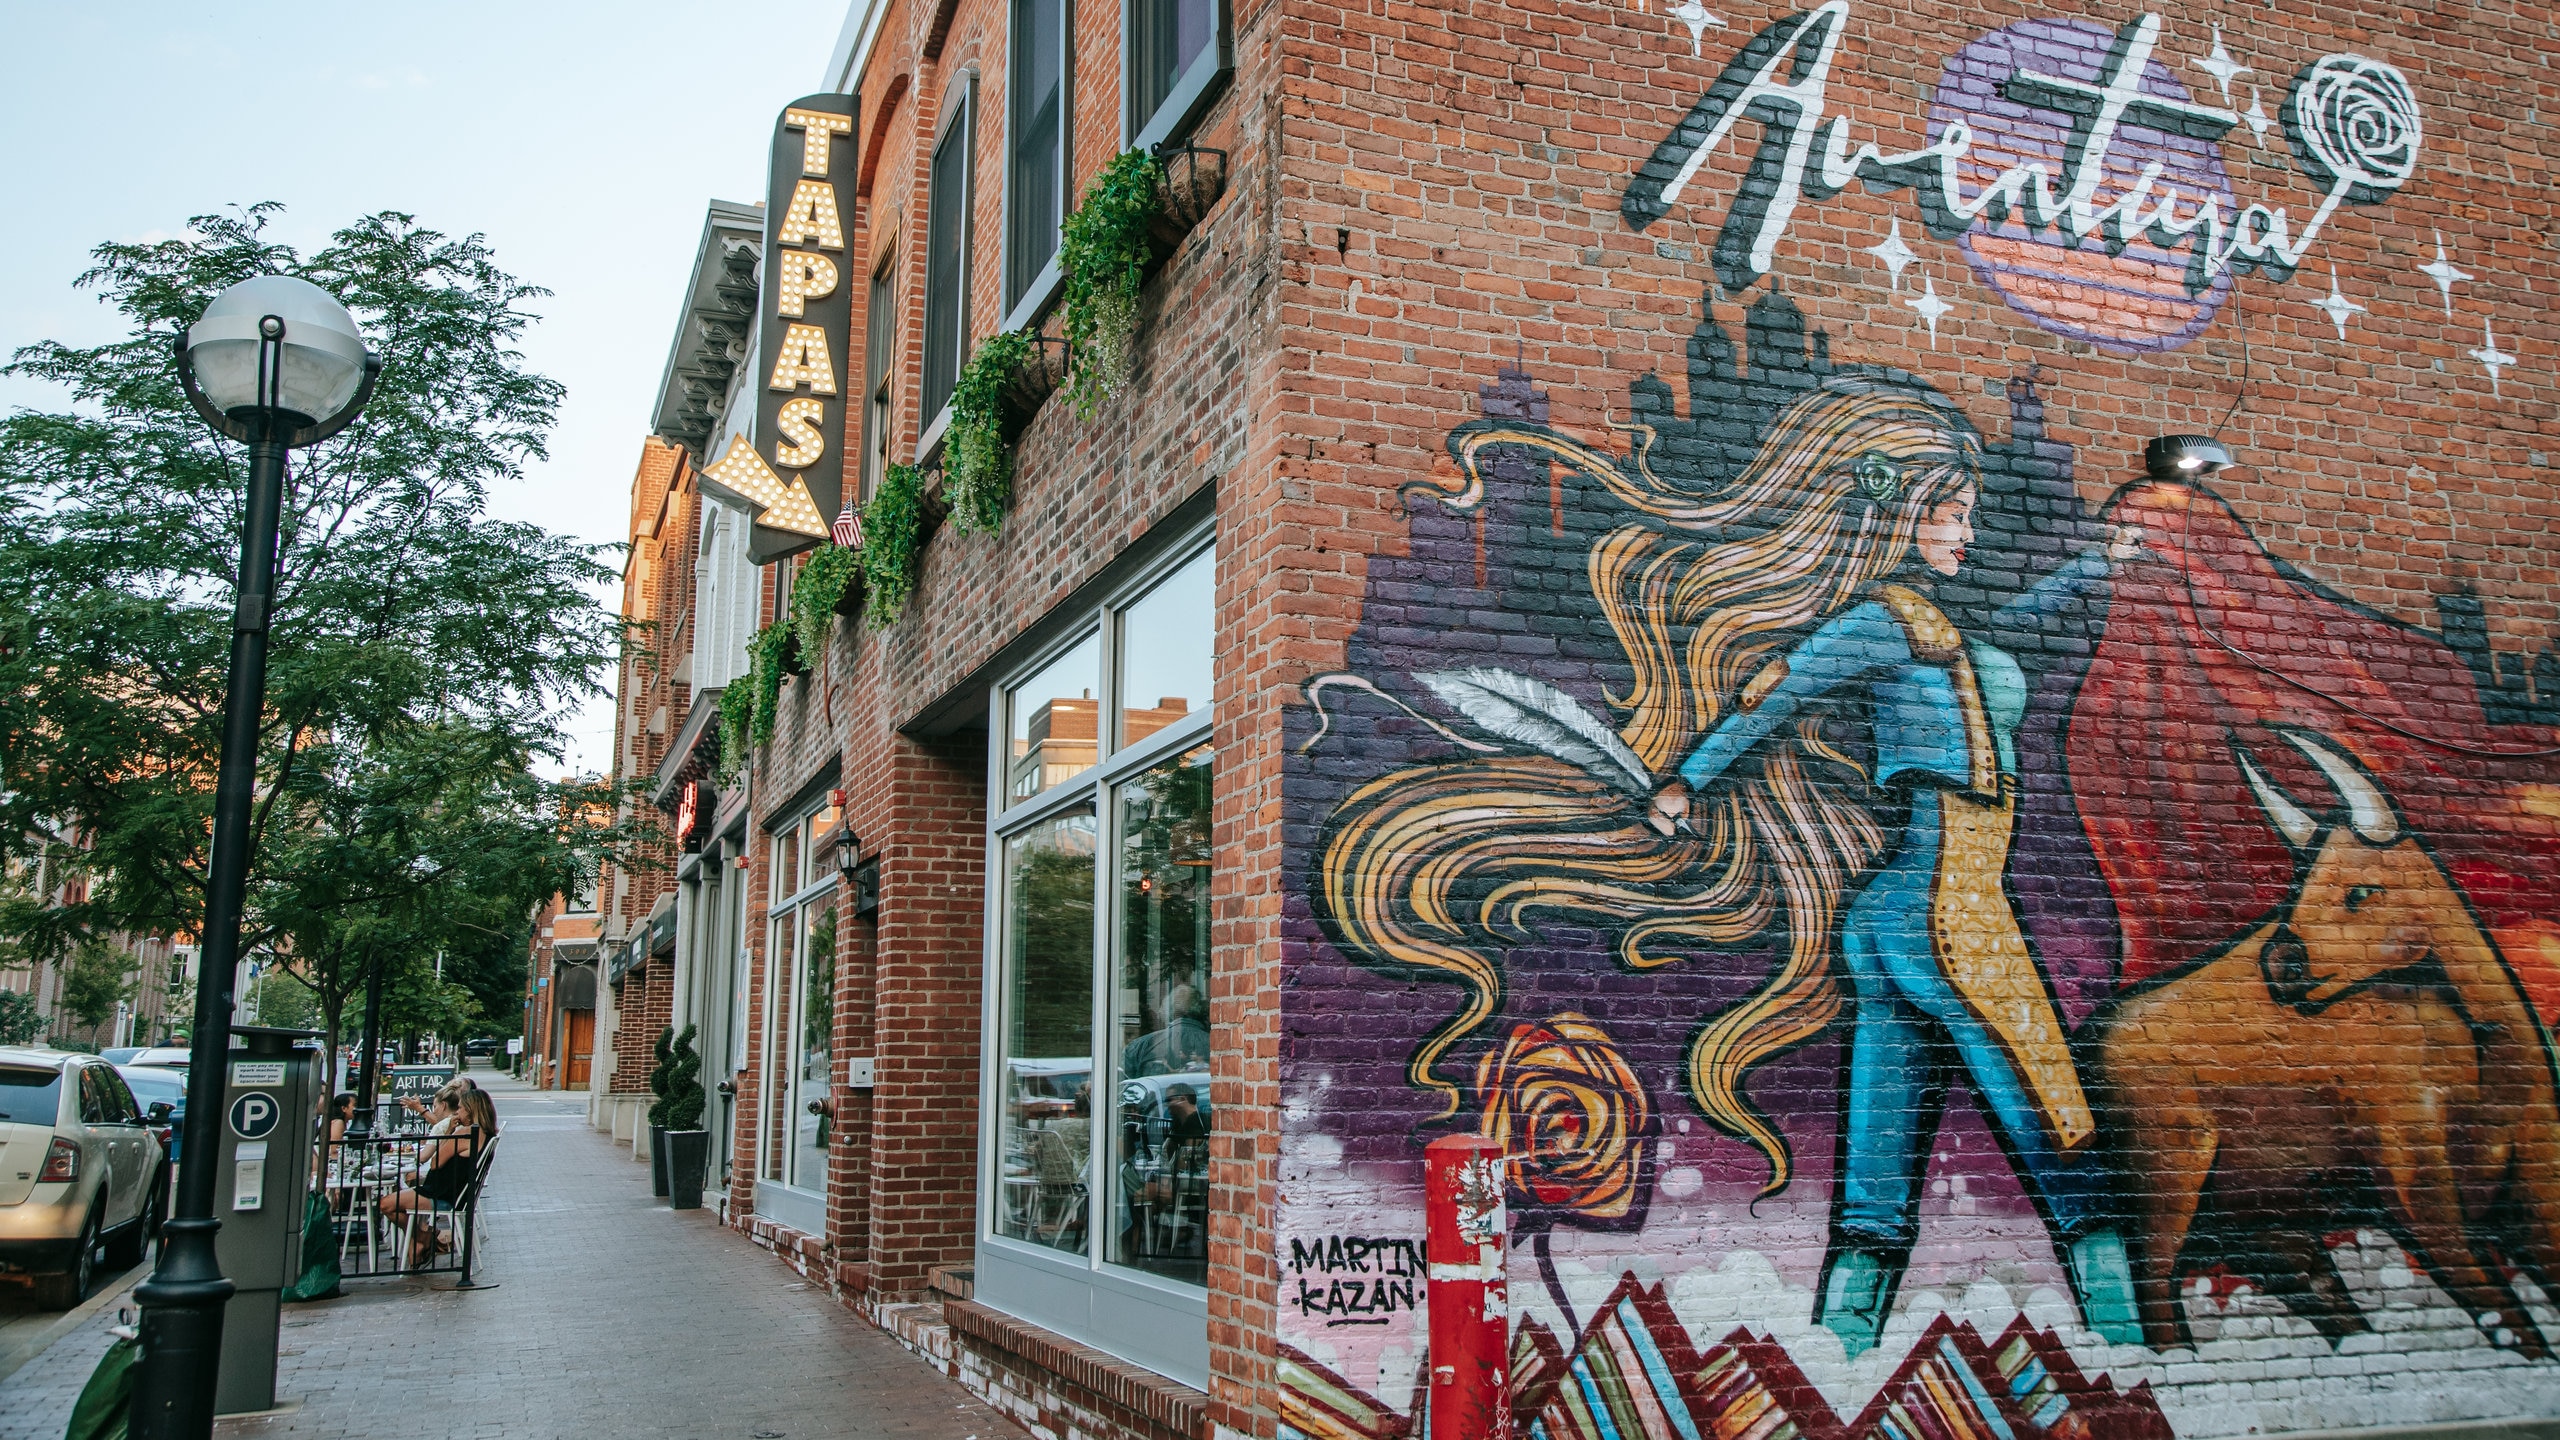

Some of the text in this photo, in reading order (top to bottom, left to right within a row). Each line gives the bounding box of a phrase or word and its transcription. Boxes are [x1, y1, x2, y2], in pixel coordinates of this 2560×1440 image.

[767, 107, 853, 468] TAPAS
[395, 1074, 445, 1090] ART FAIR
[243, 1099, 270, 1131] P
